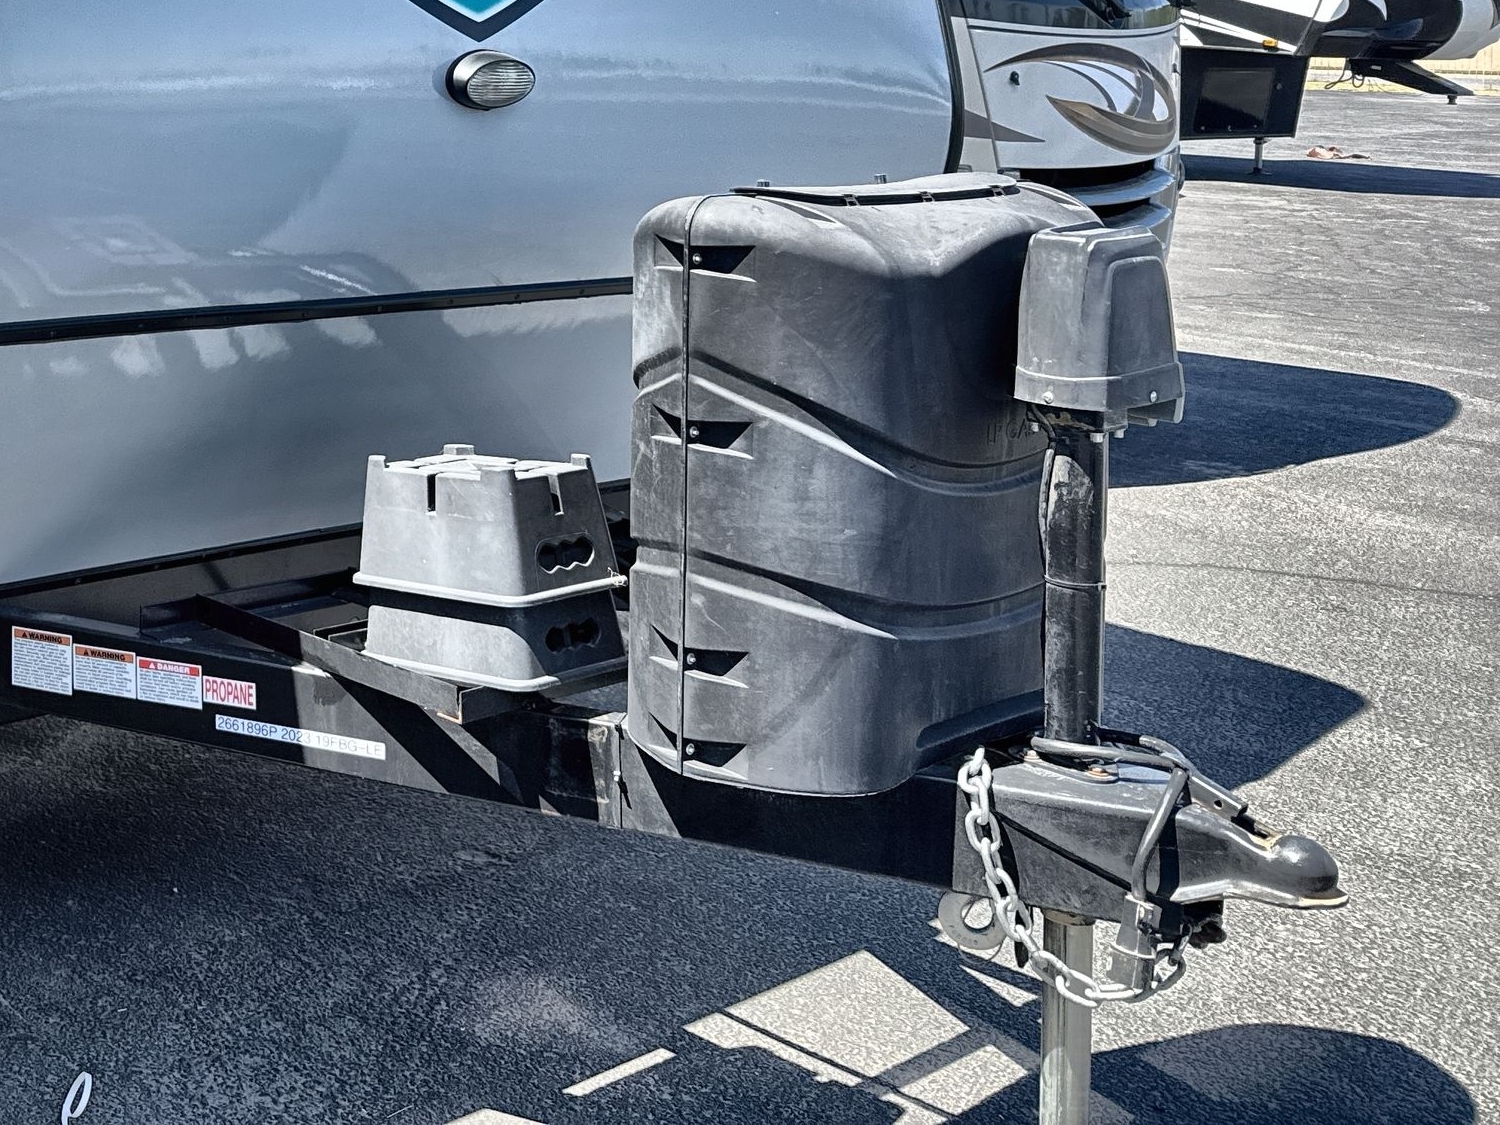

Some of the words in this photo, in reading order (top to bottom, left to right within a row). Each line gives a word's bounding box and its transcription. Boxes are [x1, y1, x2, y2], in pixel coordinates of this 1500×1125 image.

[29, 632, 63, 644] WARNING
[90, 650, 126, 662] WARNING
[156, 663, 191, 674] DANGER
[205, 678, 254, 706] PROPANE
[217, 716, 278, 737] 2661896P
[281, 728, 312, 744] 2023
[316, 734, 383, 756] 19FBG-LE
